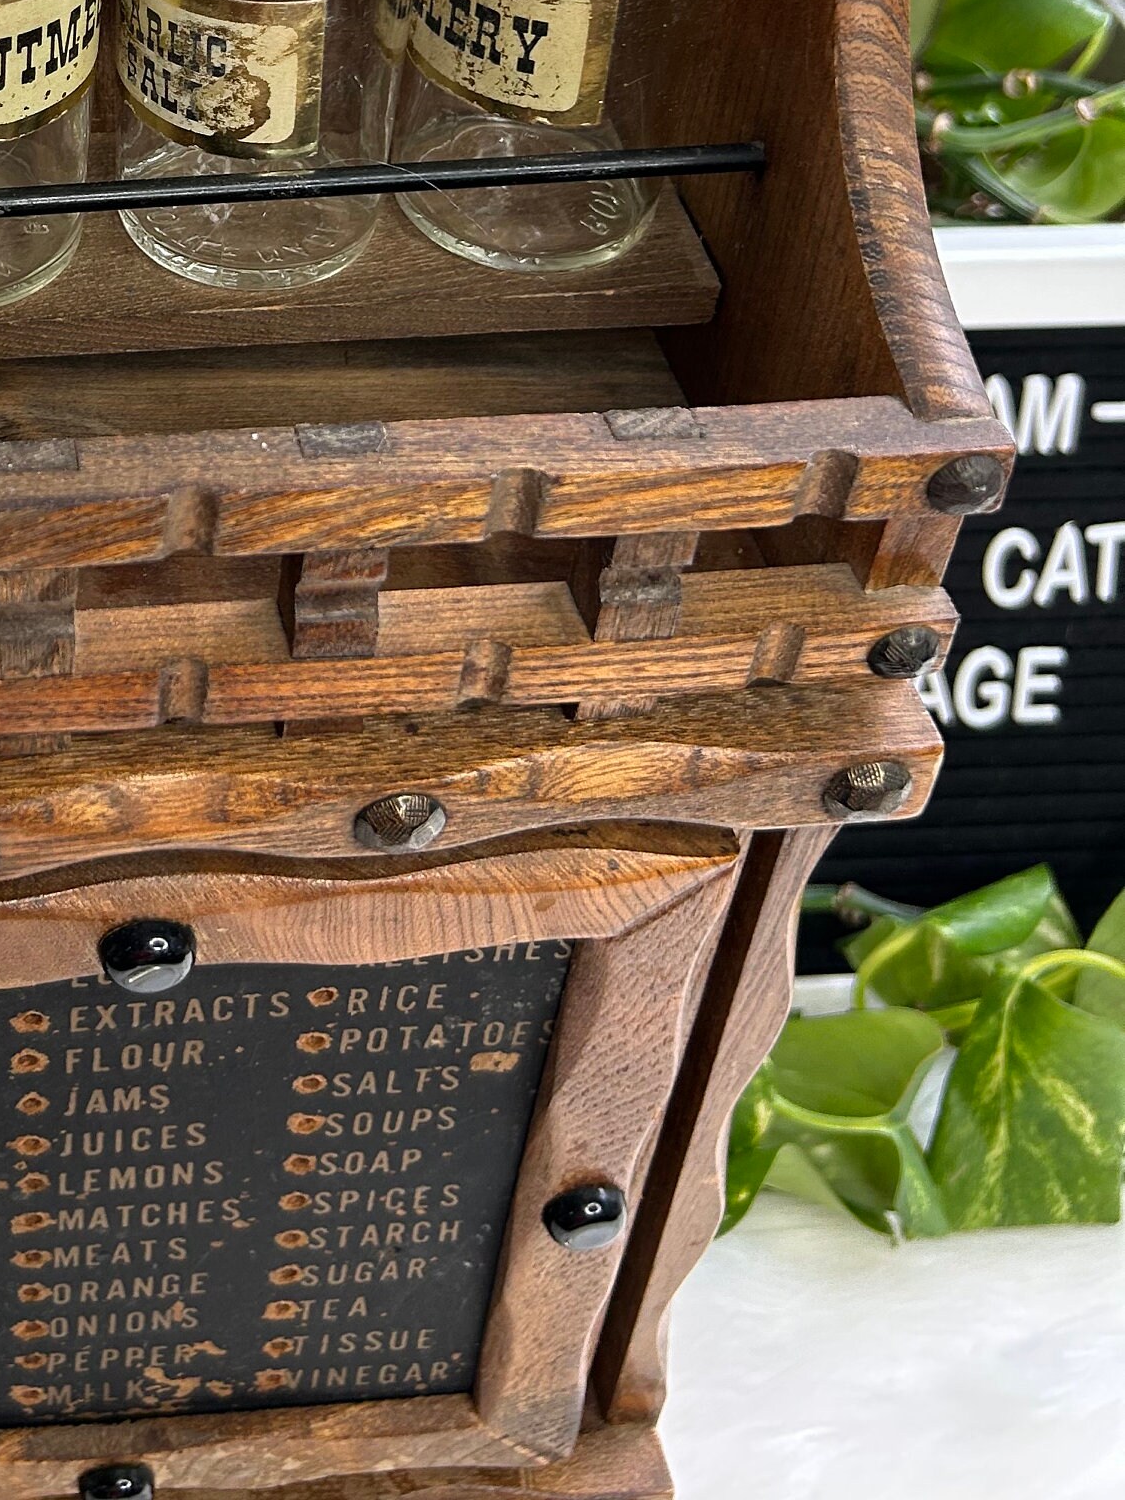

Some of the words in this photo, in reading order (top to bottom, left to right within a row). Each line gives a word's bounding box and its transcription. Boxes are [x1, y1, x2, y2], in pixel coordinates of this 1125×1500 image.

[69, 991, 290, 1032] EXTRACTS
[347, 983, 447, 1014] RICE
[65, 1039, 205, 1074] FLOUR
[331, 1065, 461, 1097] SALTS
[64, 1084, 170, 1116] JAMS
[325, 1106, 458, 1137] SOUPS
[59, 1122, 207, 1157] JUICES
[59, 1160, 223, 1195] LEMONS
[318, 1149, 422, 1176] SOAP
[313, 1183, 460, 1215] SPICES
[58, 1199, 240, 1231] MATCHES
[308, 1220, 463, 1250] STARCH
[53, 1237, 188, 1268] MEATS
[300, 1257, 427, 1286] SUGAR
[52, 1272, 208, 1304] ORANGE
[49, 1307, 199, 1338] ONIONS
[299, 1296, 368, 1320] TEA
[292, 1328, 435, 1356] TISSUE
[46, 1343, 193, 1373] PEPPER
[285, 1361, 450, 1389] VINEGAR
[46, 1379, 145, 1406] MILK
